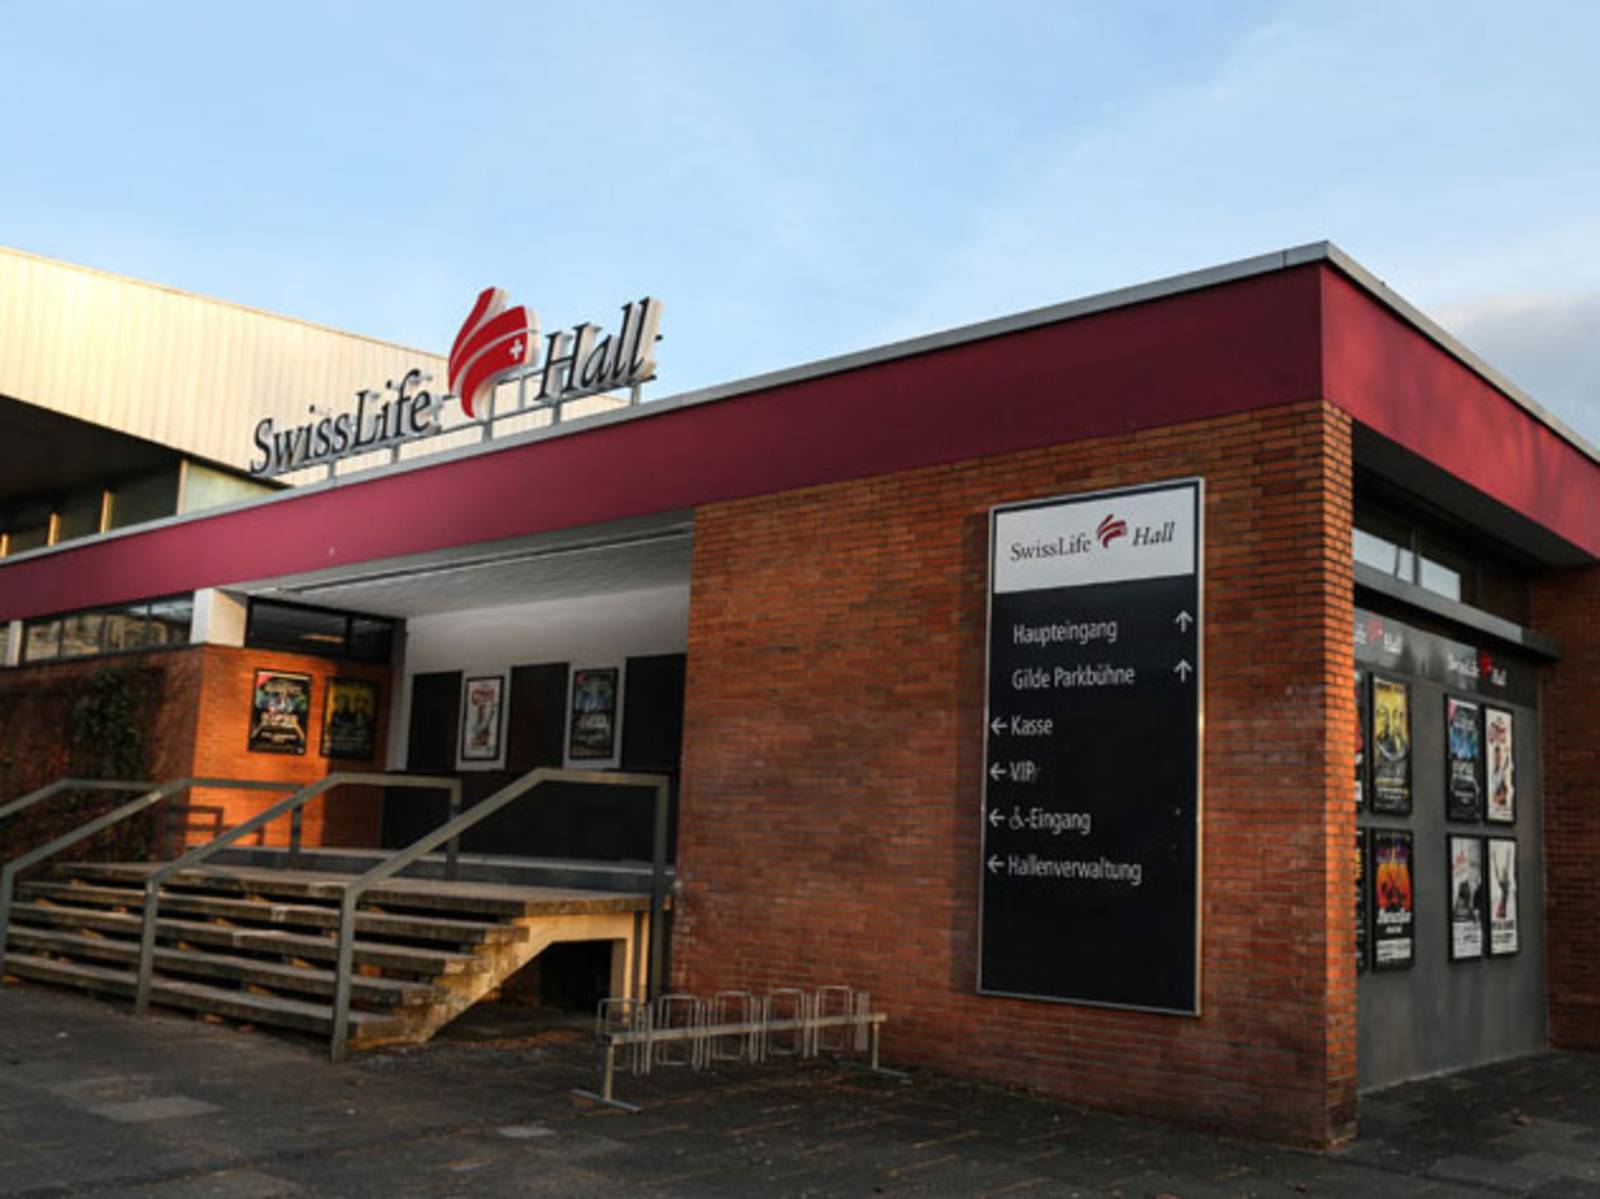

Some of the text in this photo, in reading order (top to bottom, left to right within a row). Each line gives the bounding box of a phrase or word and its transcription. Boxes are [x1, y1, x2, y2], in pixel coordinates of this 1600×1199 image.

[250, 297, 653, 478] SwissLife Hall
[1010, 521, 1175, 562] SwissLife Hall
[1013, 620, 1118, 646] Haupteingang
[1011, 662, 1136, 690] Gilde Parkbühne
[1010, 715, 1053, 736] Kasse
[1009, 760, 1037, 782] VIP
[1007, 855, 1142, 886] Hallenverwaltung
